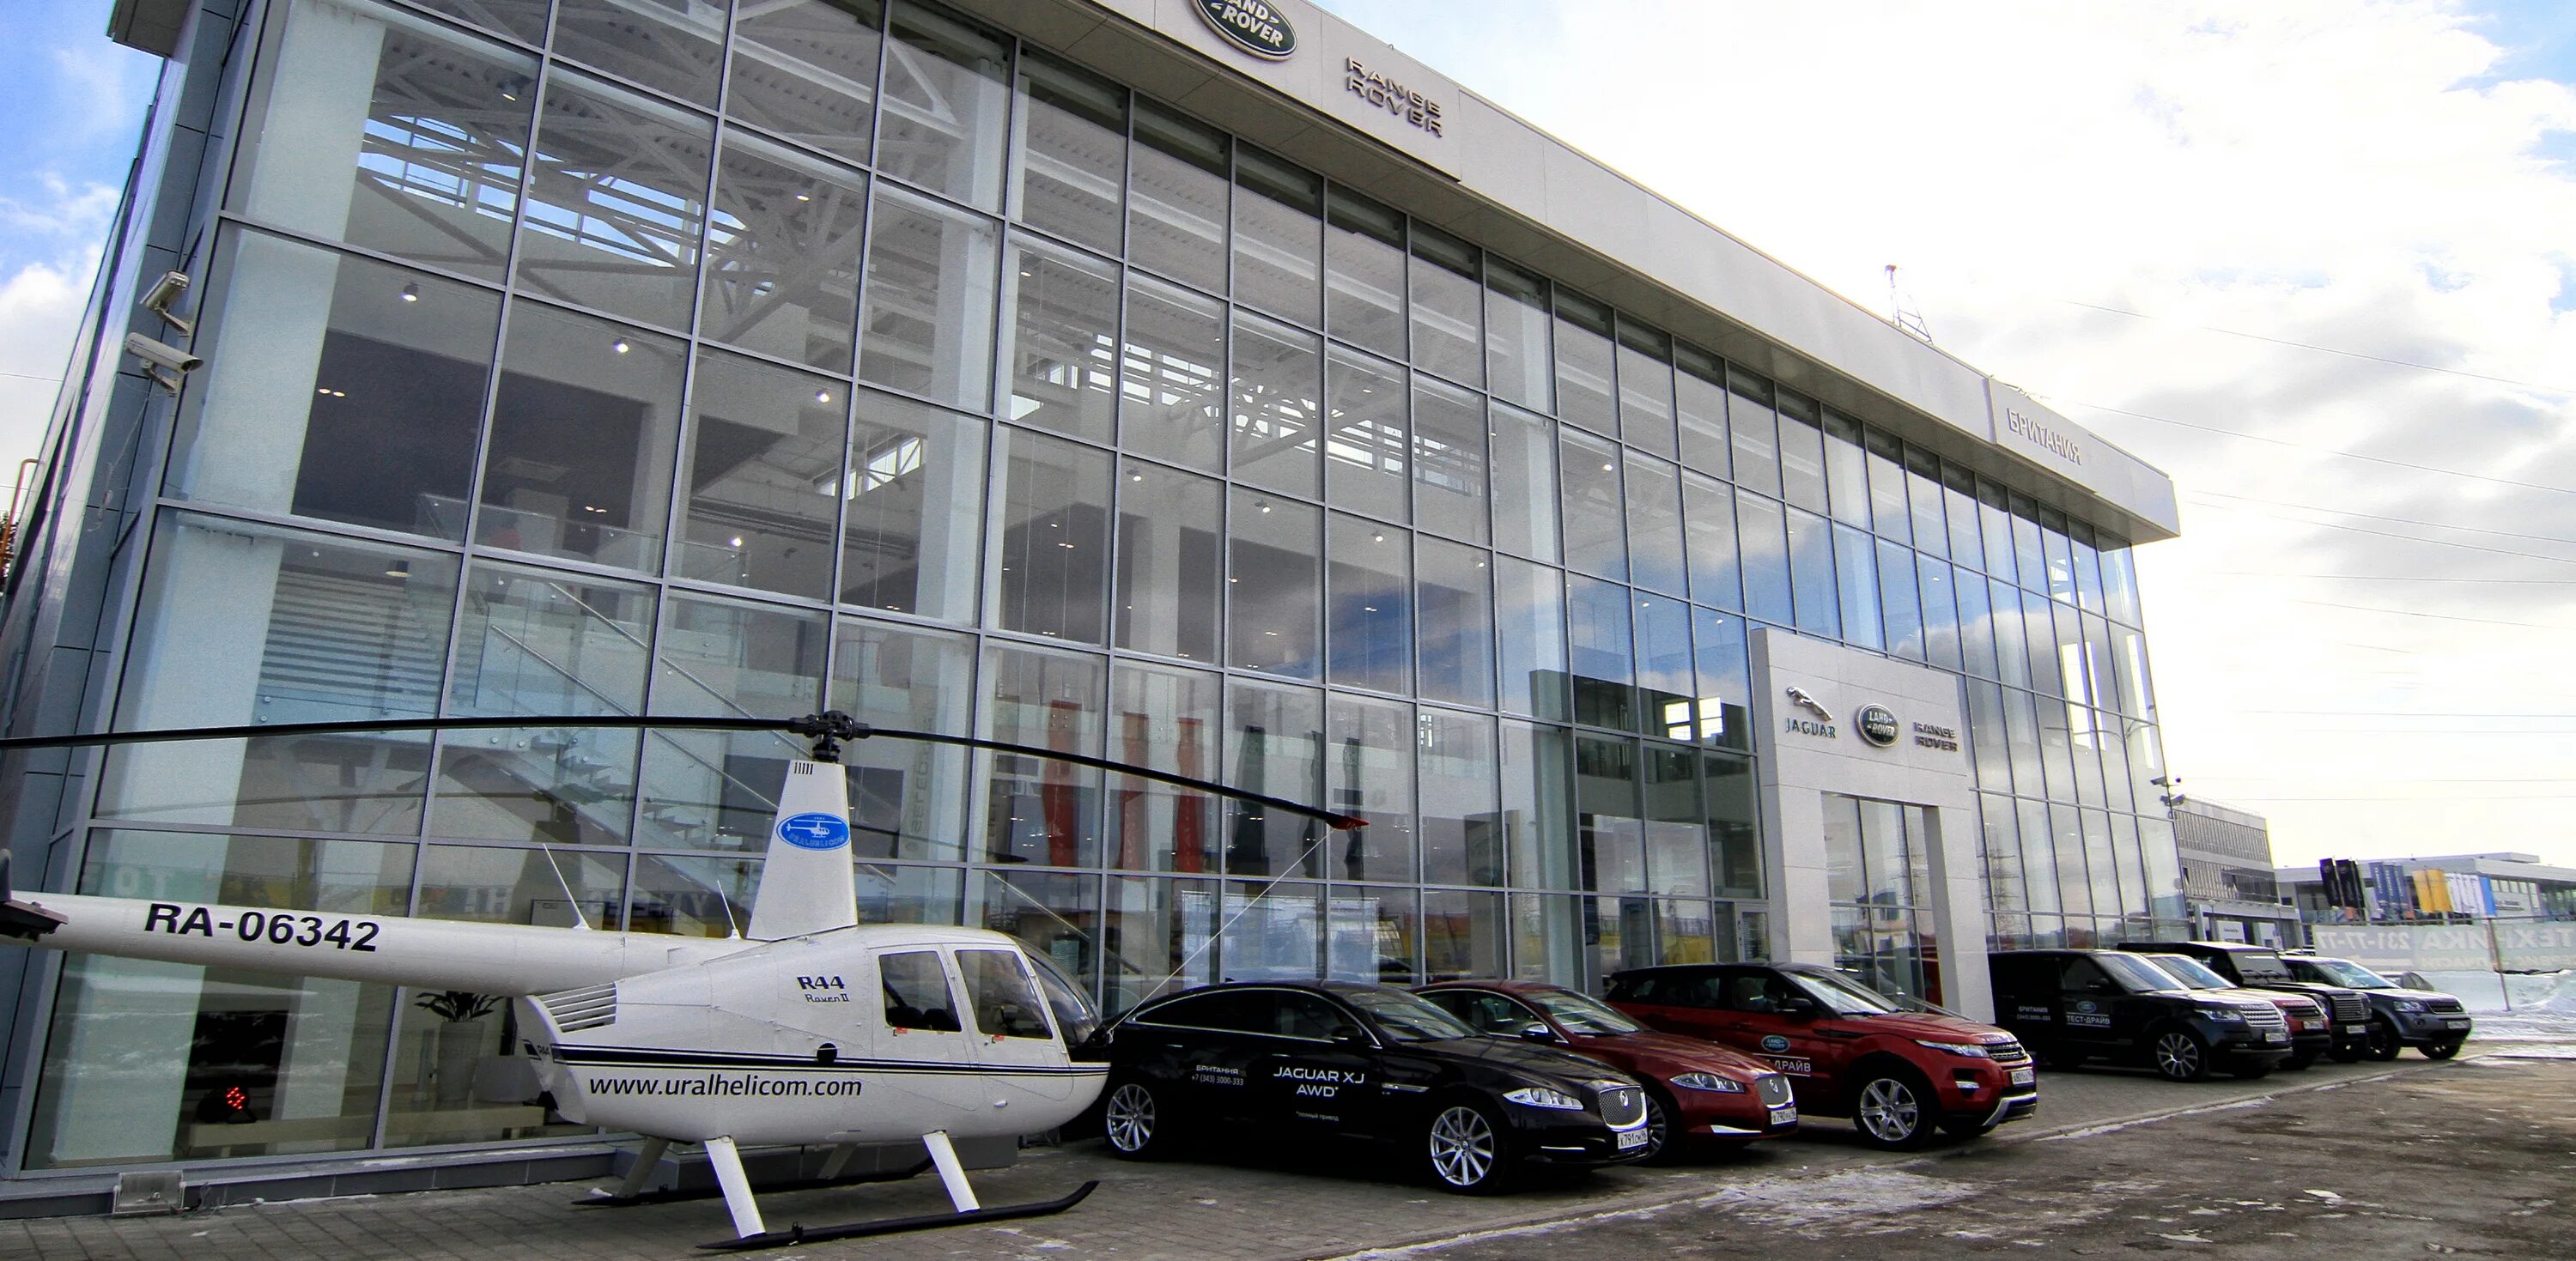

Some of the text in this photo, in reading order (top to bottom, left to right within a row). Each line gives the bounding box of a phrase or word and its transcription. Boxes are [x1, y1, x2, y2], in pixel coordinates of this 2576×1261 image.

[1224, 0, 1269, 20] AND
[1221, 4, 1284, 48] ROVER
[1346, 56, 1441, 118] RANGE
[1346, 75, 1443, 138] ROVER
[2006, 407, 2081, 466] БРИТАНИЯ
[1868, 710, 1889, 724] LAND
[1785, 718, 1837, 739] JAGUAR
[1871, 724, 1895, 737] ROVER
[1913, 721, 1956, 739] RANGE
[1914, 735, 1959, 752] ROVER
[144, 902, 380, 953] RA-06342
[796, 975, 845, 990] R44
[805, 993, 841, 1003] Raven
[2067, 1015, 2111, 1025] ТЕСТ-ДРАЙВ
[1195, 1064, 1239, 1075] БРИТАНИЯ
[1273, 1067, 1364, 1083] JAGUAR XJ
[590, 1073, 862, 1096] www.uralhelicom.com
[1192, 1073, 1244, 1086] +7 (343) 3000-333
